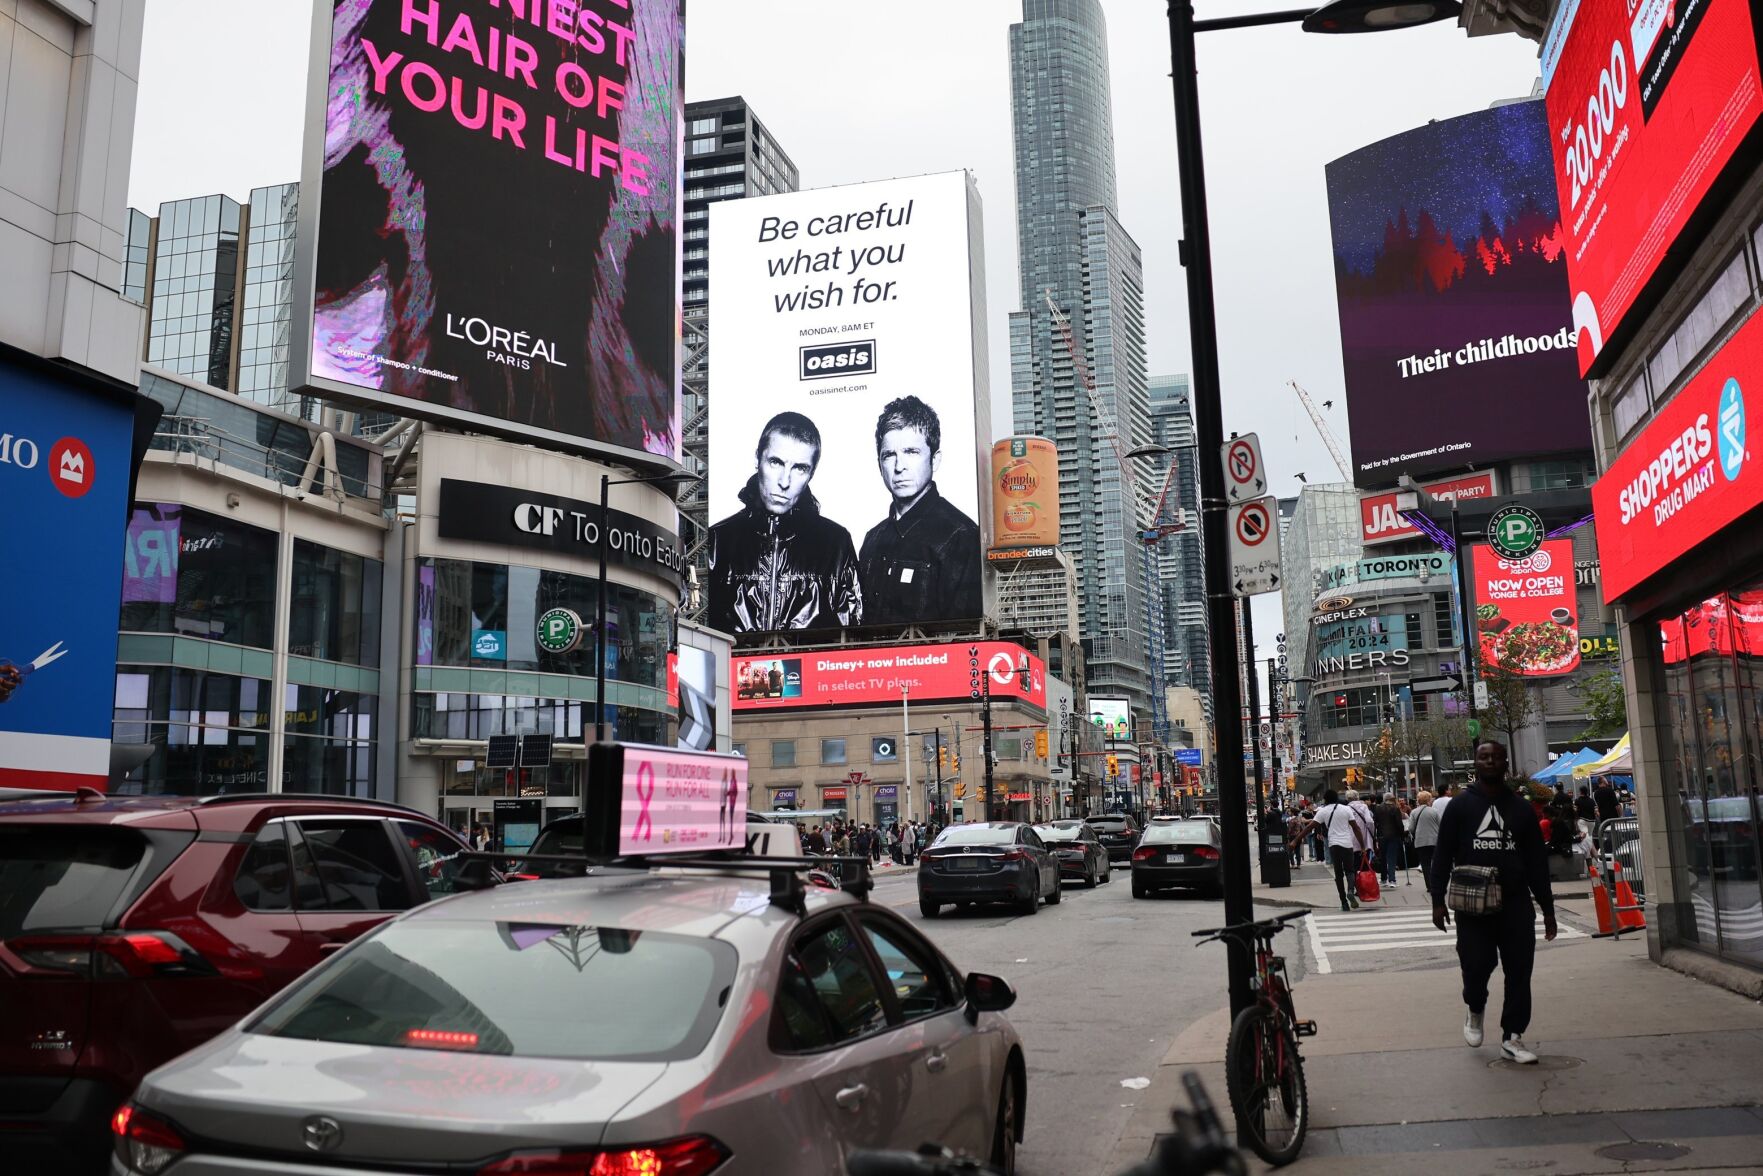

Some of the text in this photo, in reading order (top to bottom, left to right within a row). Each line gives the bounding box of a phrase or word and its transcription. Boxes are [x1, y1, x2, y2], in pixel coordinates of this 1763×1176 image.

[400, 0, 625, 119] HAIR OF
[360, 37, 650, 197] YOUR LIFE
[1566, 39, 1627, 211] 20,000
[1561, 117, 1572, 144] Your
[1607, 155, 1612, 170] is
[758, 199, 914, 243] Be careful
[767, 243, 905, 278] what you
[774, 278, 898, 314] wish for.
[799, 321, 875, 337] MONDAY, 8AM ET
[446, 313, 567, 367] L'ORÉAL
[806, 348, 869, 371] oasis
[1397, 326, 1577, 379] Their childhoods
[338, 346, 366, 359] System
[366, 354, 376, 362] of
[377, 355, 410, 370] shampoo
[418, 366, 459, 382] conditioner
[809, 383, 868, 396] oasisinet.com
[1361, 441, 1472, 472] Paid for by the Government of Ontario
[1619, 413, 1713, 525] SHOPPERS
[1458, 485, 1486, 498] PARTY
[1654, 459, 1716, 528] DRUG MART
[514, 502, 563, 536] CF
[571, 511, 651, 558] Toonto
[1491, 508, 1540, 533] MUNICIPAL
[1506, 520, 1528, 541] P
[988, 548, 1054, 560] brandedcities
[1492, 536, 1541, 557] PARKING
[1364, 557, 1442, 575] TORONTO
[1488, 578, 1522, 592] NOW
[1526, 576, 1564, 589] OPEN
[1489, 588, 1564, 600] YONGE & COLLEGE
[540, 610, 574, 628] MUNICIPAL
[1314, 607, 1368, 625] CINEPLEX
[550, 620, 564, 637] P
[1348, 622, 1388, 637] FAL
[540, 632, 574, 649] PARKING
[1350, 634, 1389, 649] 2024
[816, 652, 948, 674] Disney+ now included
[816, 674, 923, 692] in select TV plans.
[1307, 740, 1400, 762] SHAKE SHA
[666, 762, 682, 778] RUN
[682, 764, 698, 780] FOR
[666, 781, 710, 799] RUN FOR ALL
[1473, 838, 1516, 850] Reebok
